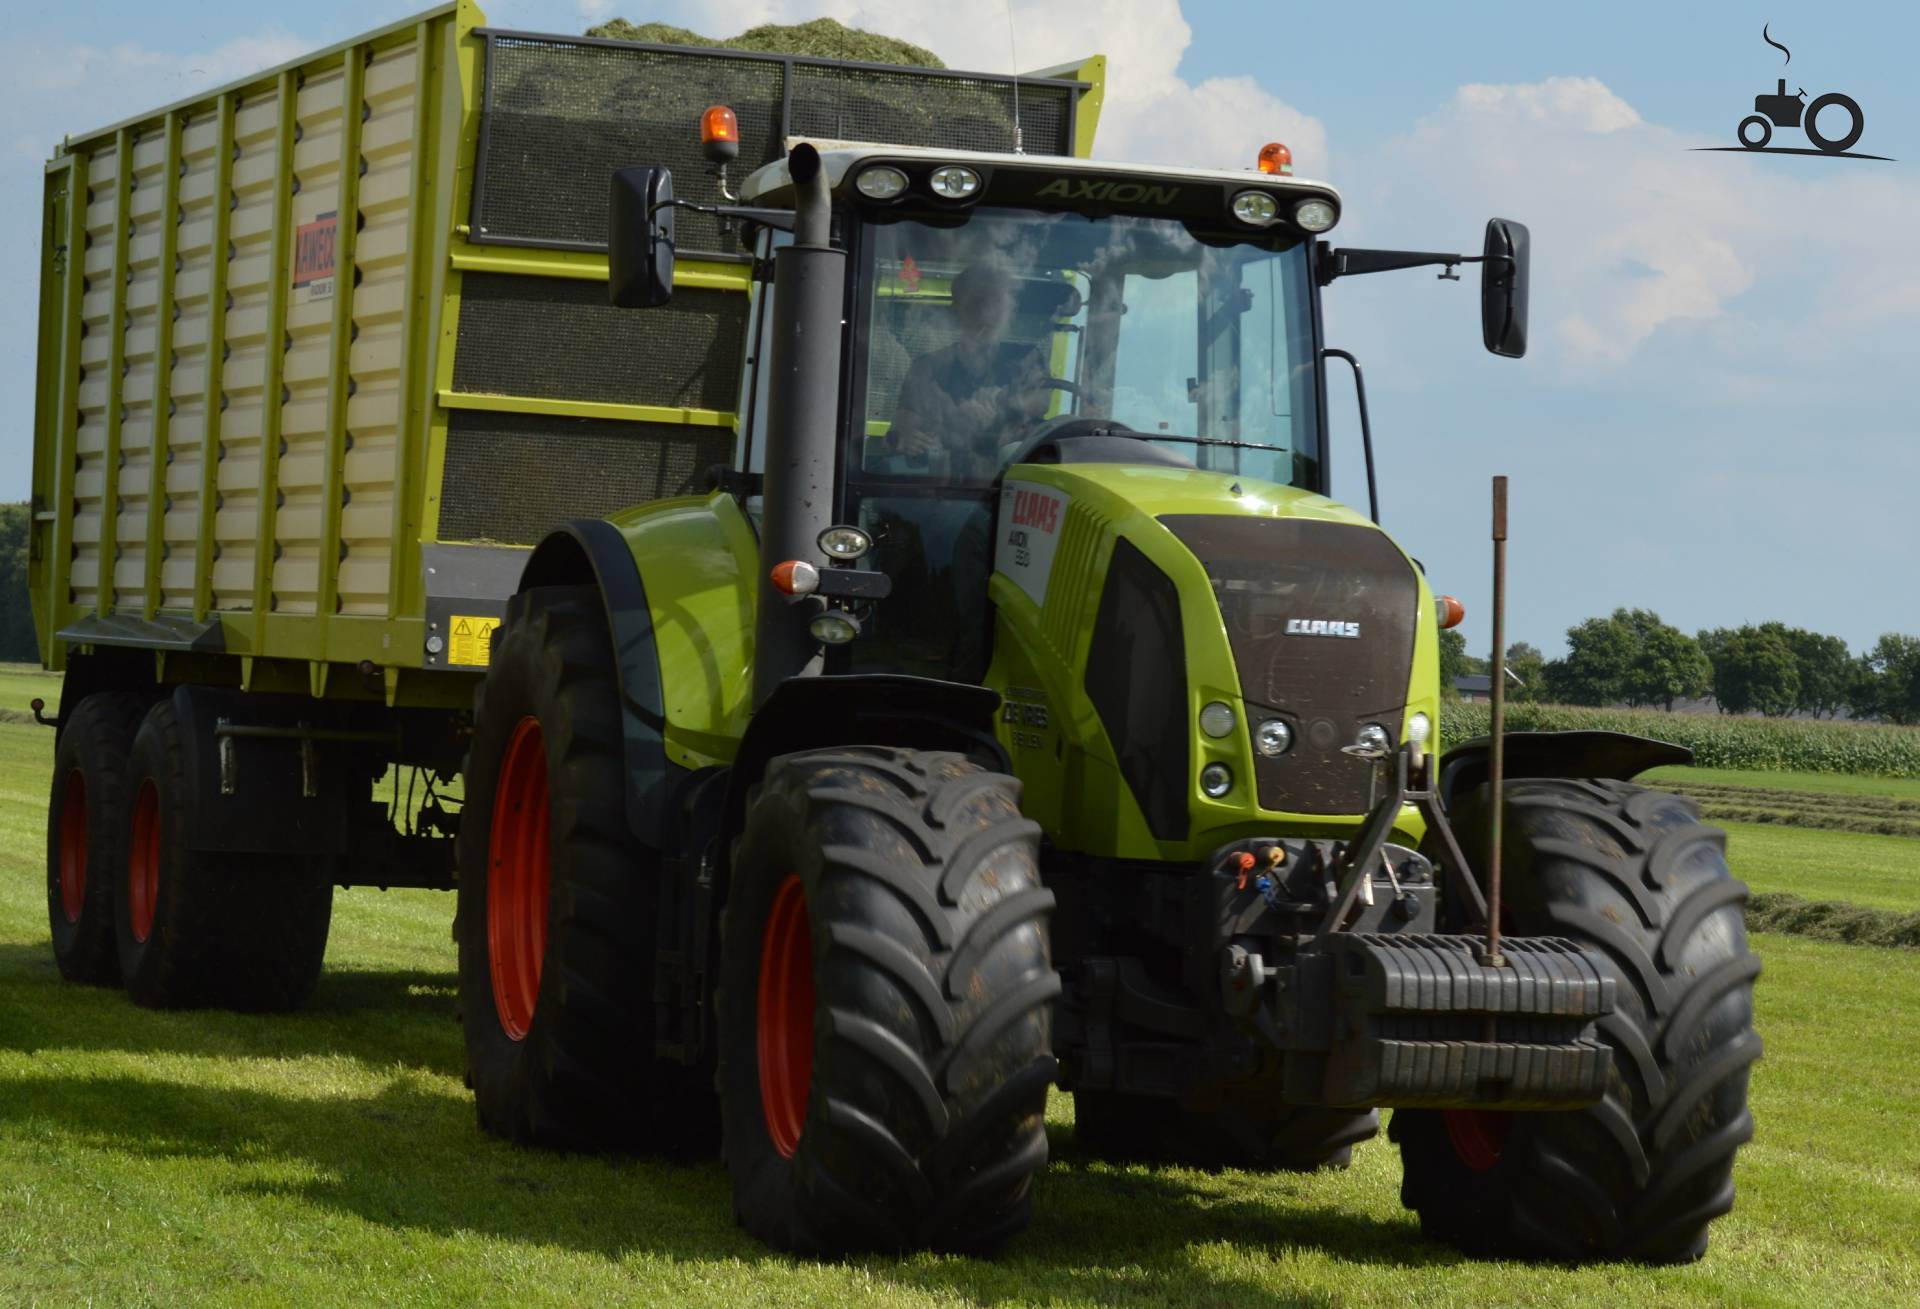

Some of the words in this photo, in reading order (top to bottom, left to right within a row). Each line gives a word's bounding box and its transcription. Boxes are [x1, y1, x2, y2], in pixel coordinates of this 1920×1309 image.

[1034, 178, 1181, 204] AXION
[1011, 490, 1060, 534] CLAAS
[1287, 619, 1360, 637] CLAAS
